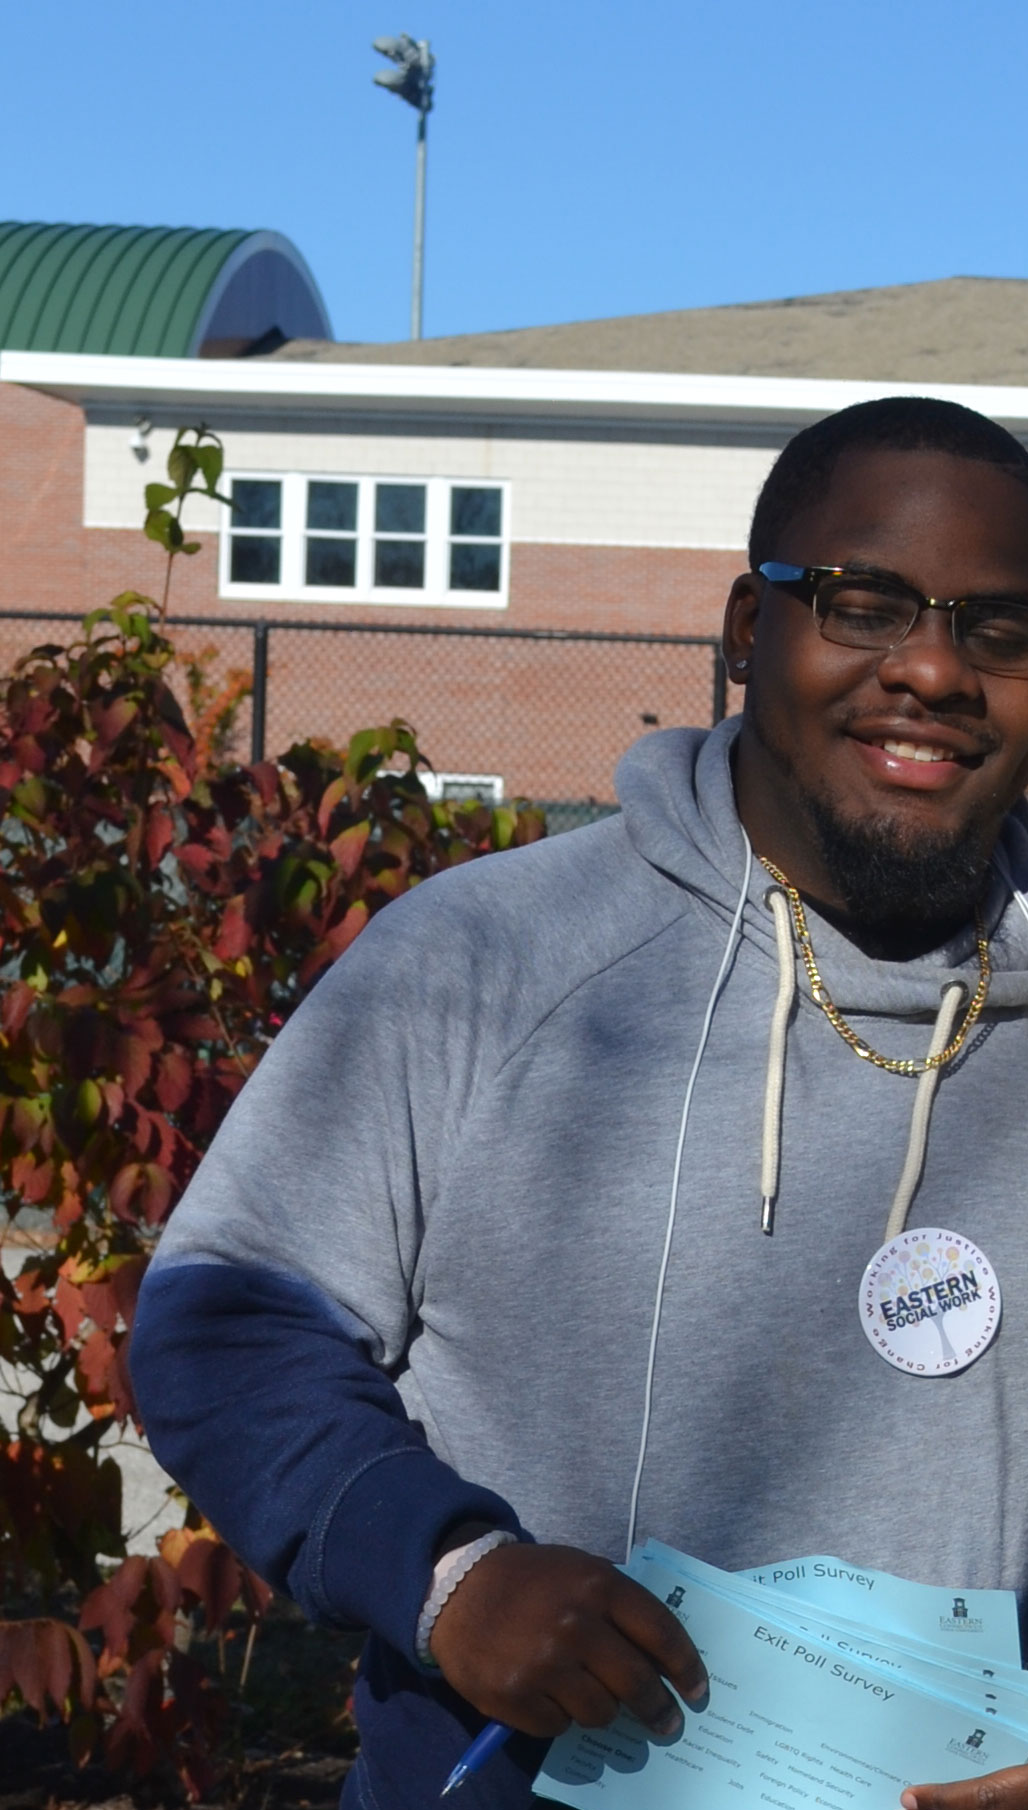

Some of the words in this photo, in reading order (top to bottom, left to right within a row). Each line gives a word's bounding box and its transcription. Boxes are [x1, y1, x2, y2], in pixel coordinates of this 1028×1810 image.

[904, 1234, 927, 1245] for
[936, 1233, 989, 1276] Justice
[866, 1247, 898, 1317] Working
[880, 1270, 979, 1321] EASTERN
[886, 1305, 938, 1332] SOCIAL
[938, 1289, 982, 1313] WORK
[964, 1286, 996, 1357] Working
[872, 1328, 925, 1371] Change
[936, 1358, 959, 1370] for
[752, 1575, 767, 1586] it
[773, 1565, 805, 1583] Poll
[813, 1563, 875, 1591] Survey
[753, 1626, 789, 1651] Exit
[793, 1645, 827, 1668] Poll
[830, 1664, 895, 1701] Survey
[698, 1725, 734, 1744] Education
[707, 1710, 735, 1726] Student
[736, 1723, 755, 1734] Debt
[749, 1711, 793, 1733] Immigration
[665, 1752, 704, 1771] Healthcare
[682, 1738, 704, 1752] Racial
[705, 1748, 741, 1768] Inequality
[755, 1750, 779, 1765] Safety
[774, 1740, 800, 1756] LGBTQ
[801, 1752, 823, 1765] Rights
[728, 1779, 744, 1790] Jobs
[760, 1772, 786, 1788] Foreign
[787, 1784, 809, 1798] Policy
[788, 1765, 825, 1785] Homeland
[825, 1781, 855, 1798] Security
[830, 1765, 853, 1779] Health
[855, 1776, 872, 1787] Care
